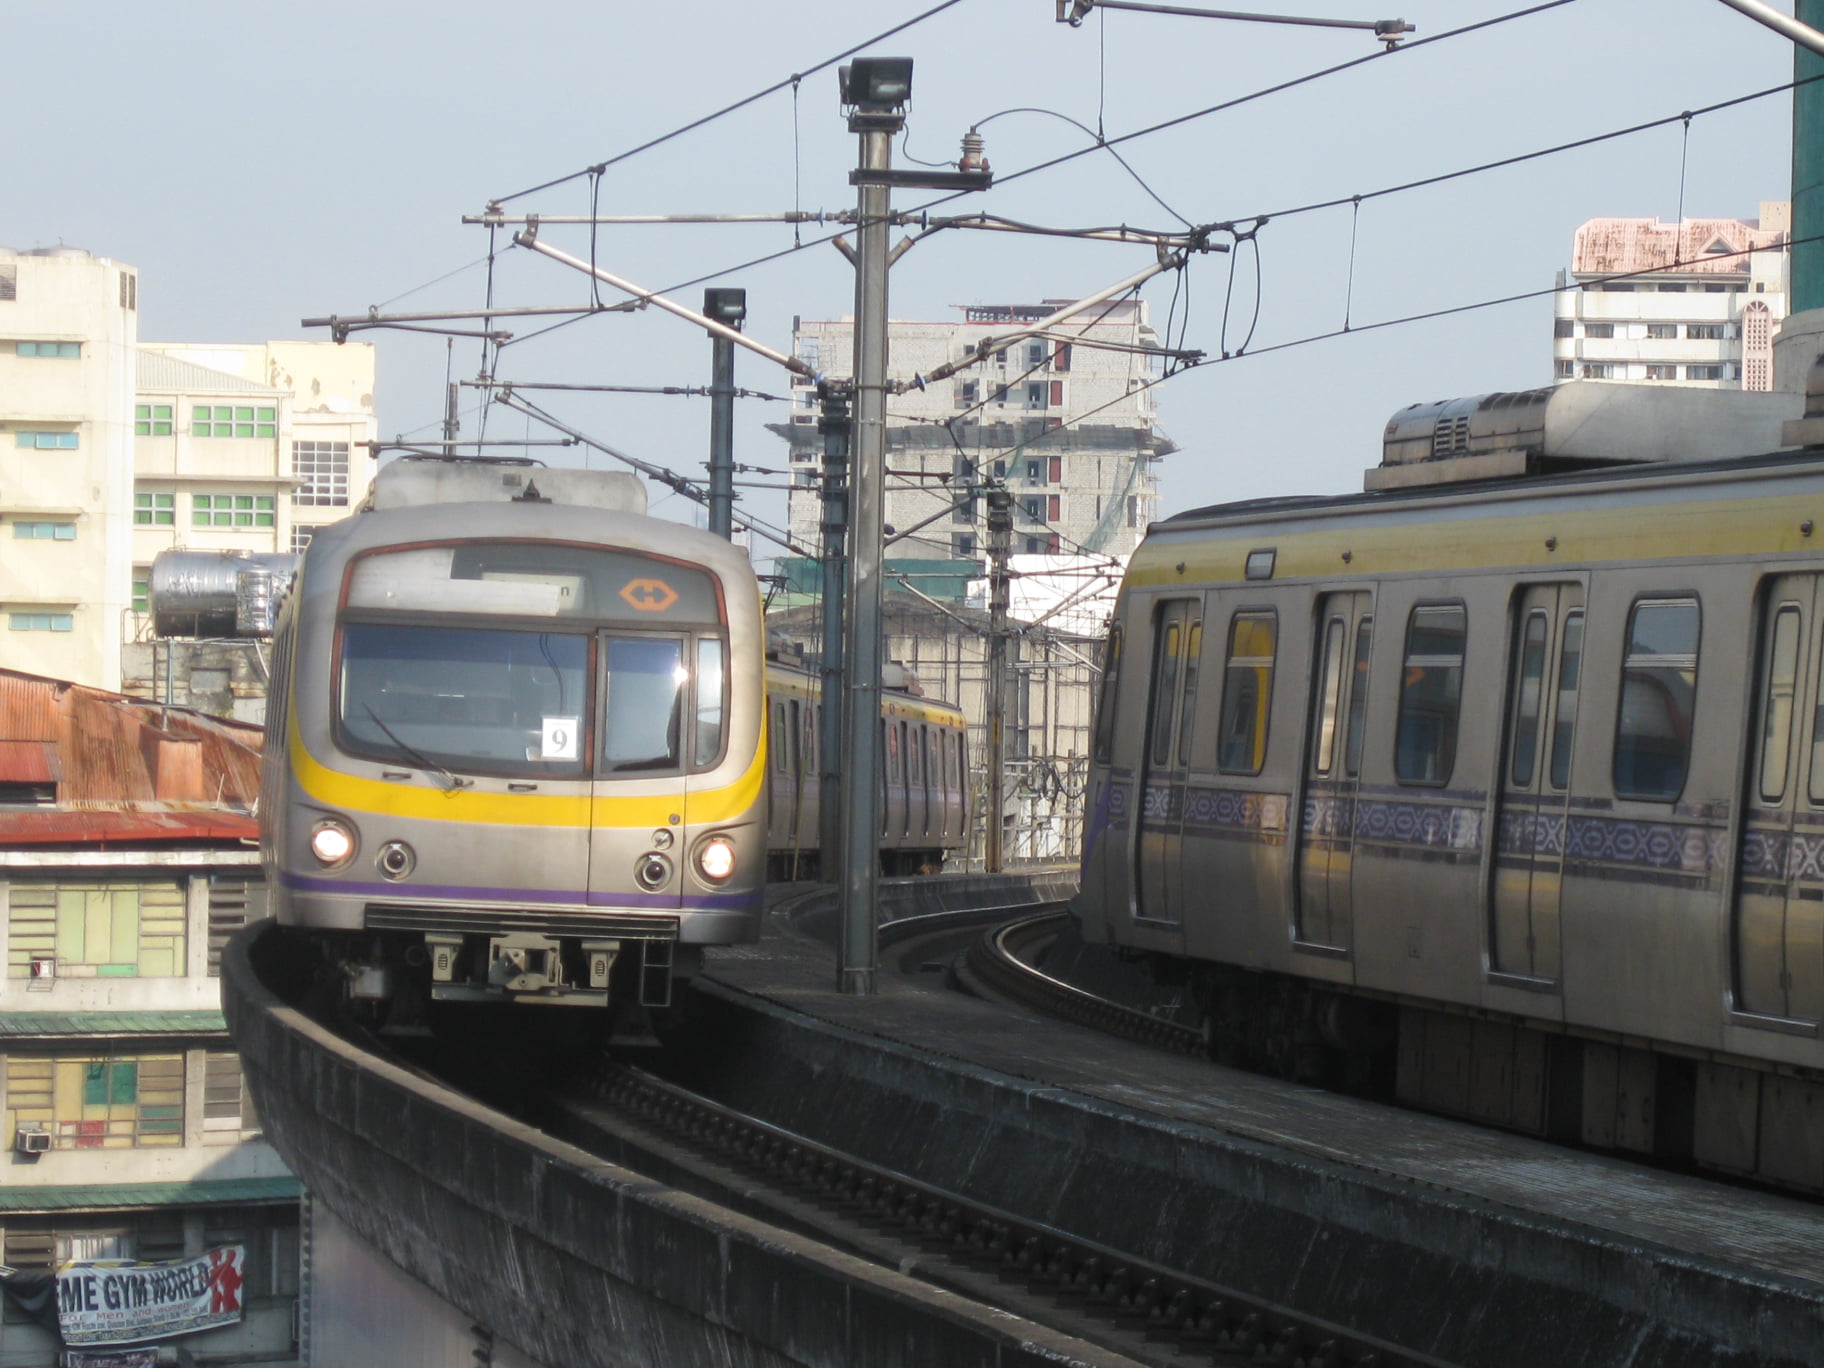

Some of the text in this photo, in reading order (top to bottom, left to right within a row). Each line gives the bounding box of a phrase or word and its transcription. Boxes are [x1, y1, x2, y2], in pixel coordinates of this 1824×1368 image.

[551, 728, 568, 753] 9
[103, 1274, 147, 1310] GYM
[149, 1263, 210, 1304] WORLD
[96, 1311, 124, 1320] Men
[132, 1308, 151, 1317] and
